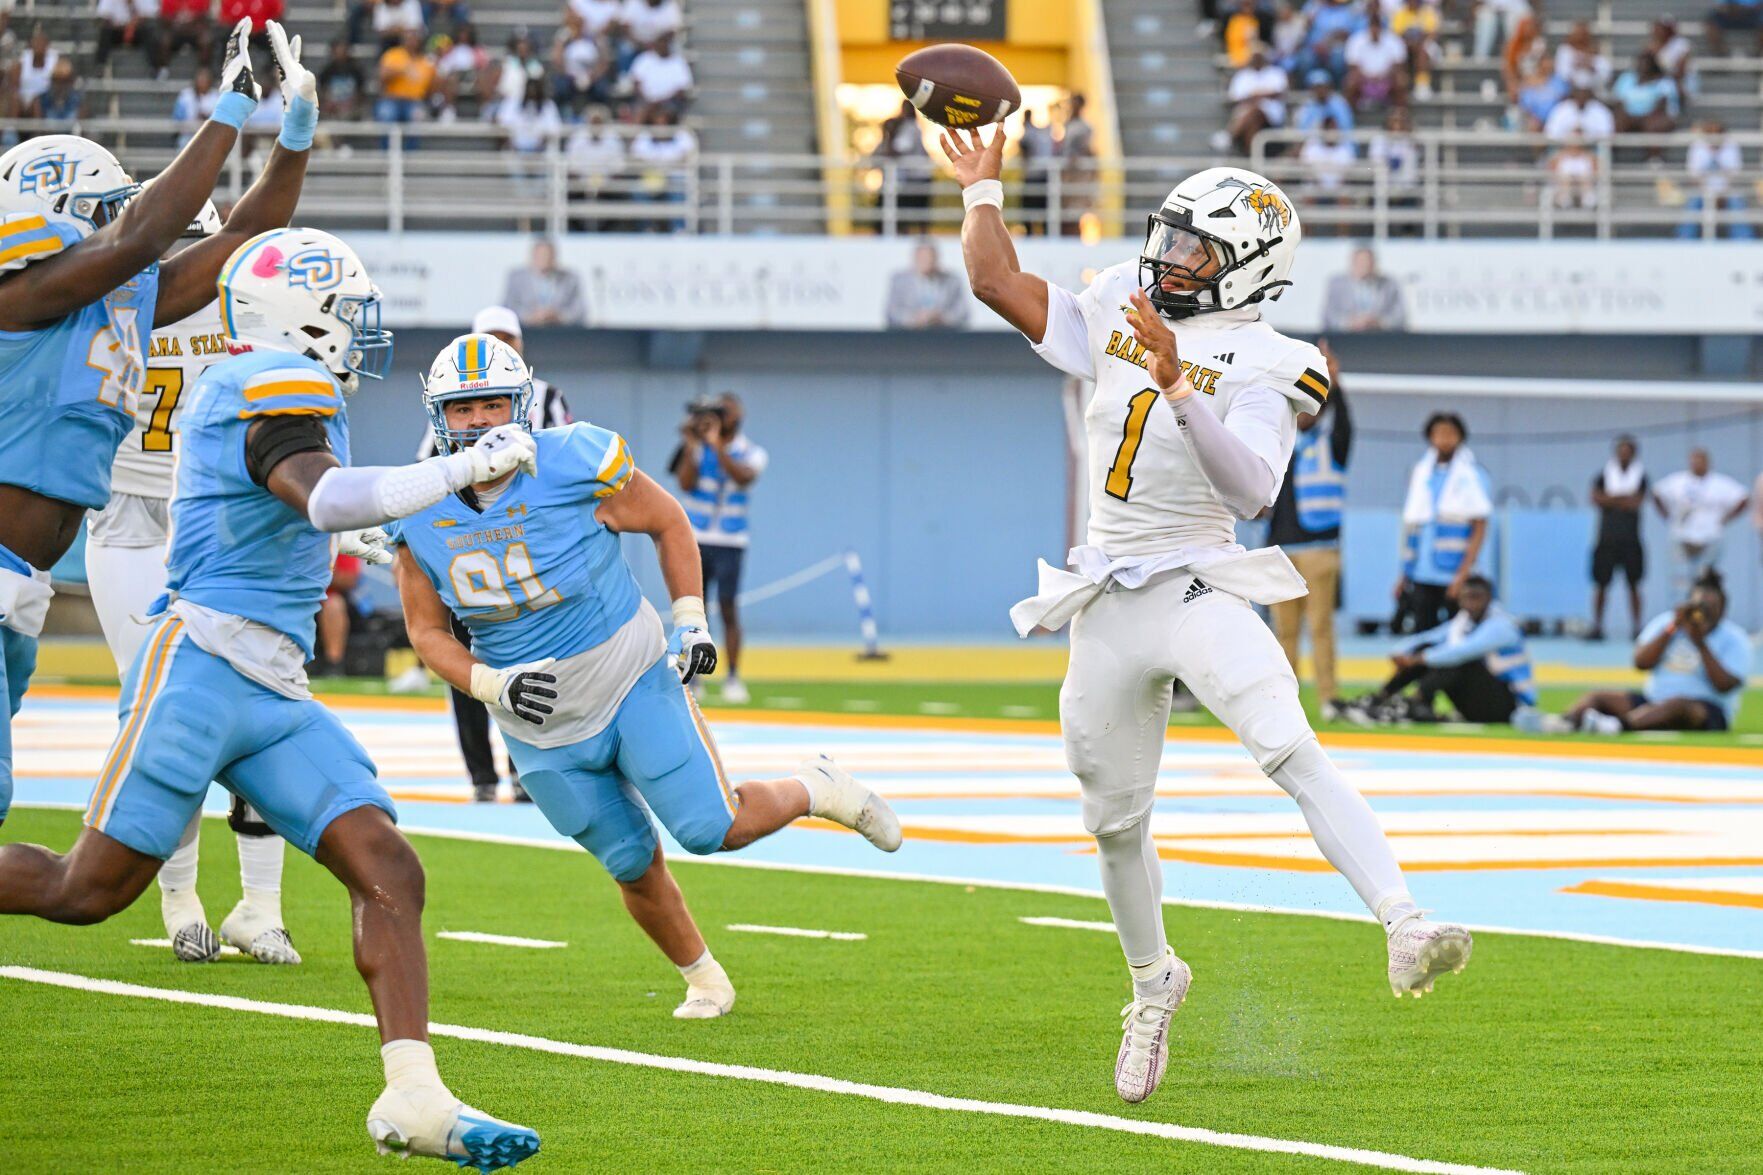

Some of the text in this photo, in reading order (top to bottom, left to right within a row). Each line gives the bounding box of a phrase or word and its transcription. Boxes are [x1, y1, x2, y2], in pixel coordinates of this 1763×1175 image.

[288, 249, 344, 291] SU
[148, 336, 183, 357] AMA
[190, 333, 227, 355] STAT
[460, 380, 489, 390] Riddell
[1178, 358, 1223, 396] TATE
[1105, 387, 1160, 502] 1
[445, 524, 526, 550] SOUTHERN
[449, 541, 564, 622] 91
[1183, 587, 1213, 603] adidas
